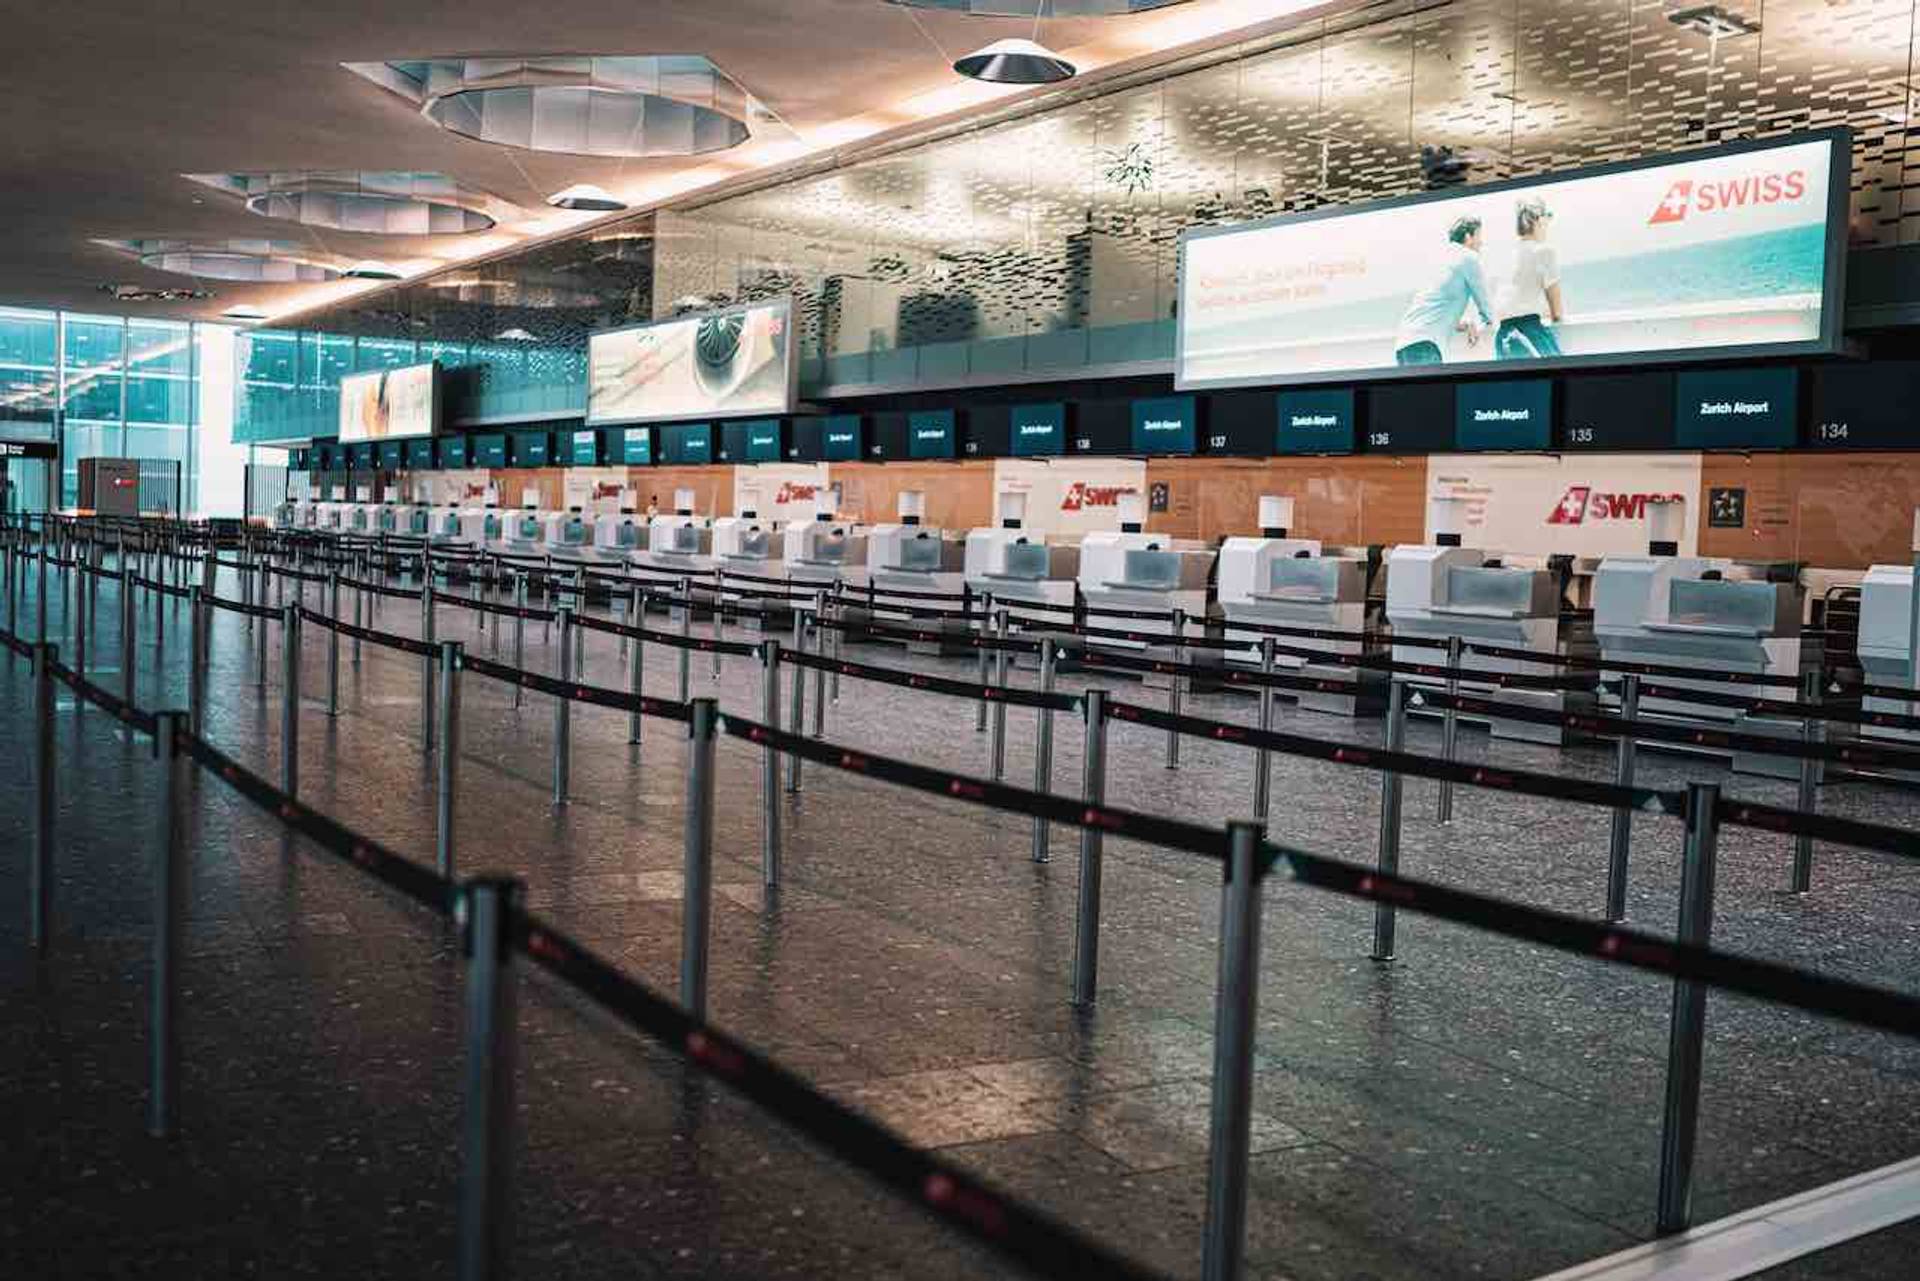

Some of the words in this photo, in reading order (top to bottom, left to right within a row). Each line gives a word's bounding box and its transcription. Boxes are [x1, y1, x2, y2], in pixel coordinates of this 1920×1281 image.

[1697, 170, 1805, 211] SWISS
[1700, 402, 1732, 415] Zurich
[1733, 401, 1768, 415] Airport
[1571, 428, 1594, 442] 135
[1822, 423, 1848, 440] 134
